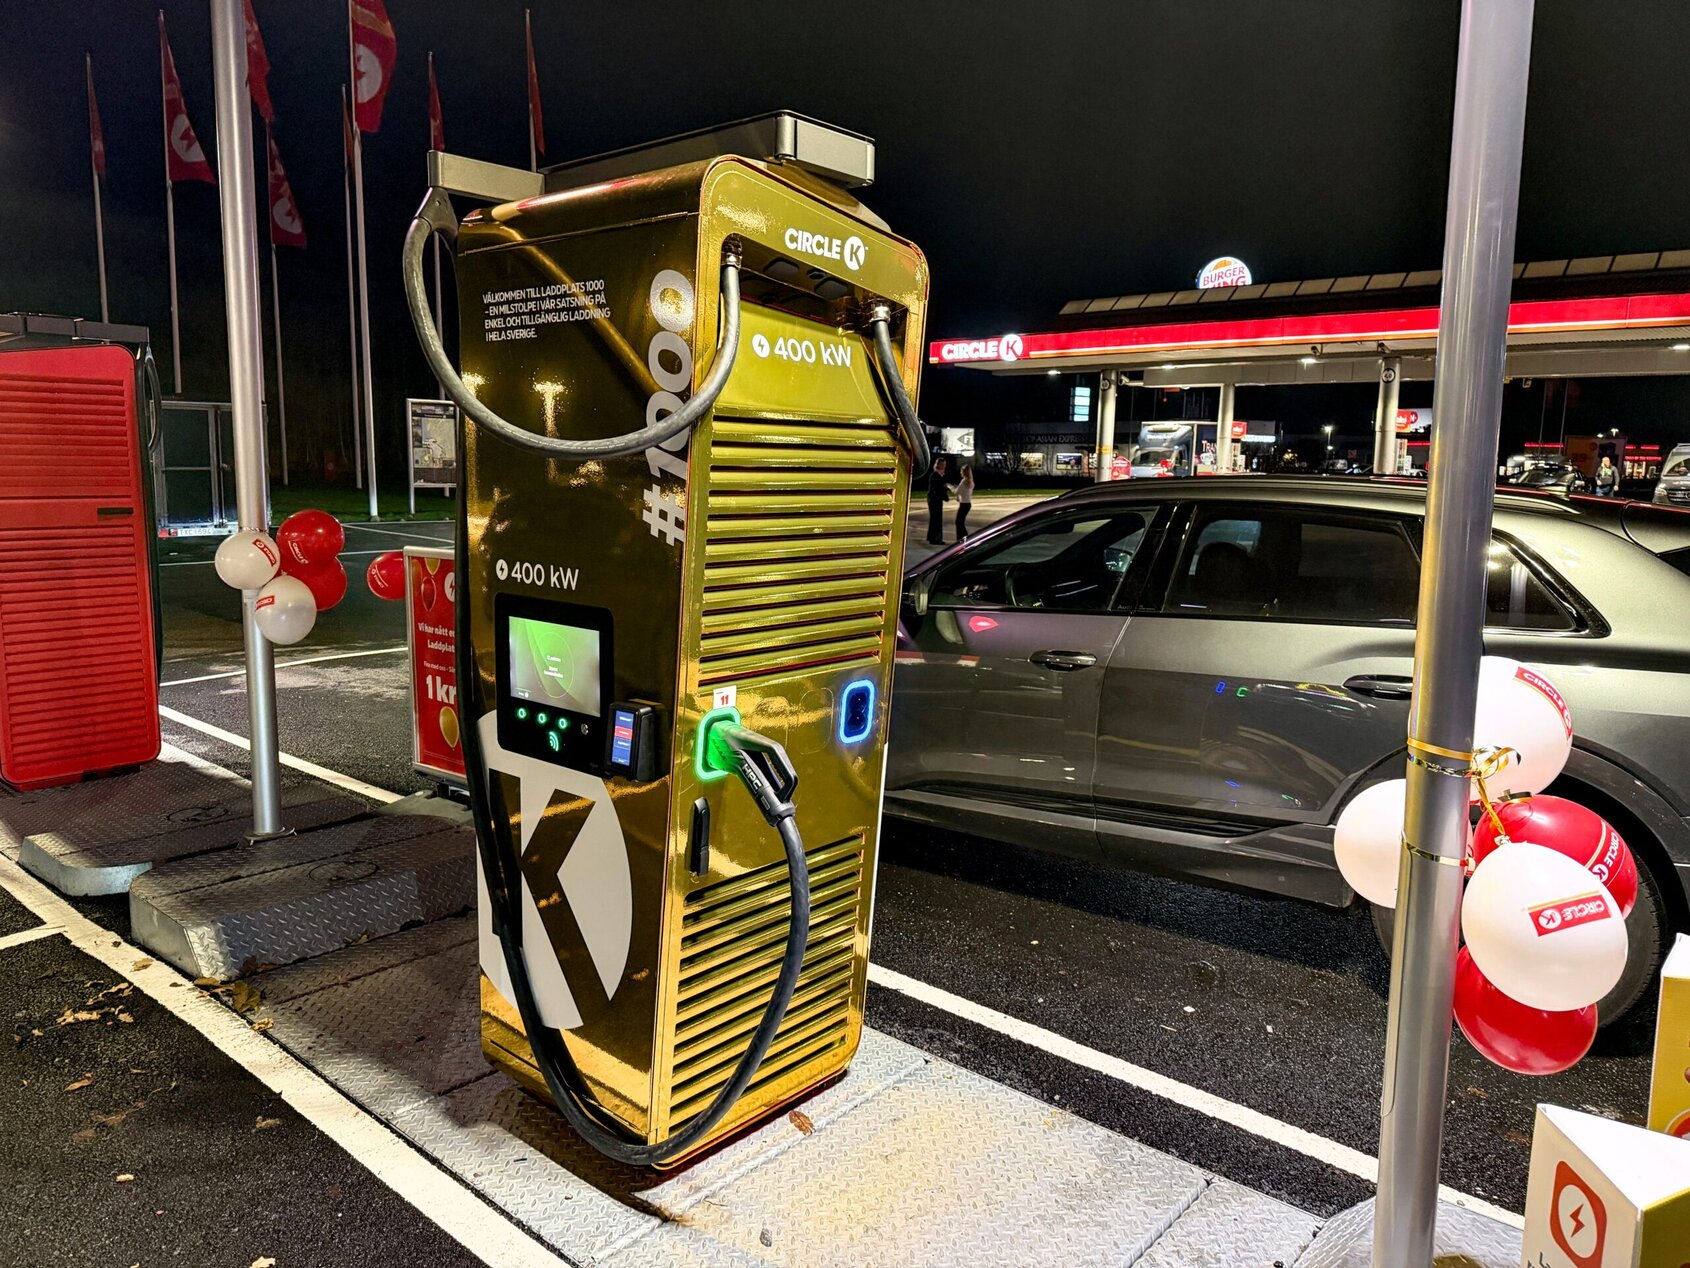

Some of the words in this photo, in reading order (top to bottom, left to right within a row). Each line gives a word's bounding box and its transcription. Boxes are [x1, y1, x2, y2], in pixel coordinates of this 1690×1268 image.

[785, 228, 841, 260] CIRCLE
[847, 239, 864, 269] K
[1203, 266, 1245, 287] BURGER
[482, 288, 526, 304] VÄLKOMMEN
[526, 287, 540, 298] TILL
[541, 282, 585, 296] LADDPLATS
[586, 280, 604, 292] 1000
[489, 306, 498, 316] EN
[498, 301, 536, 314] MILSTOLPE
[540, 298, 556, 310] VÅR
[556, 296, 594, 308] SATSNING
[595, 292, 606, 304] PÅ
[484, 318, 506, 329] ENKEL
[506, 316, 520, 327] OCH
[521, 312, 568, 326] TILLGÄNGLIG
[569, 307, 611, 321] LADDNING
[488, 330, 506, 341] HELA
[506, 328, 538, 340] SVERIGE.
[774, 337, 816, 363] 400
[820, 341, 851, 367] kW
[942, 341, 998, 360] CIRCLE
[1002, 336, 1022, 361] K
[642, 269, 695, 546] #1000
[511, 561, 546, 586] 400
[550, 564, 580, 591] kW
[418, 622, 424, 632] Vi
[424, 624, 434, 634] har
[434, 625, 448, 636] nått
[426, 674, 434, 700] 1
[436, 676, 456, 704] kr
[720, 694, 729, 706] 11
[1523, 672, 1564, 709] CIRCLE
[742, 763, 763, 790] HPC
[1604, 832, 1620, 868] CIRCLE
[1592, 866, 1607, 882] K
[487, 762, 613, 1027] K
[1540, 910, 1560, 928] K
[1562, 900, 1604, 920] CIRCLE
